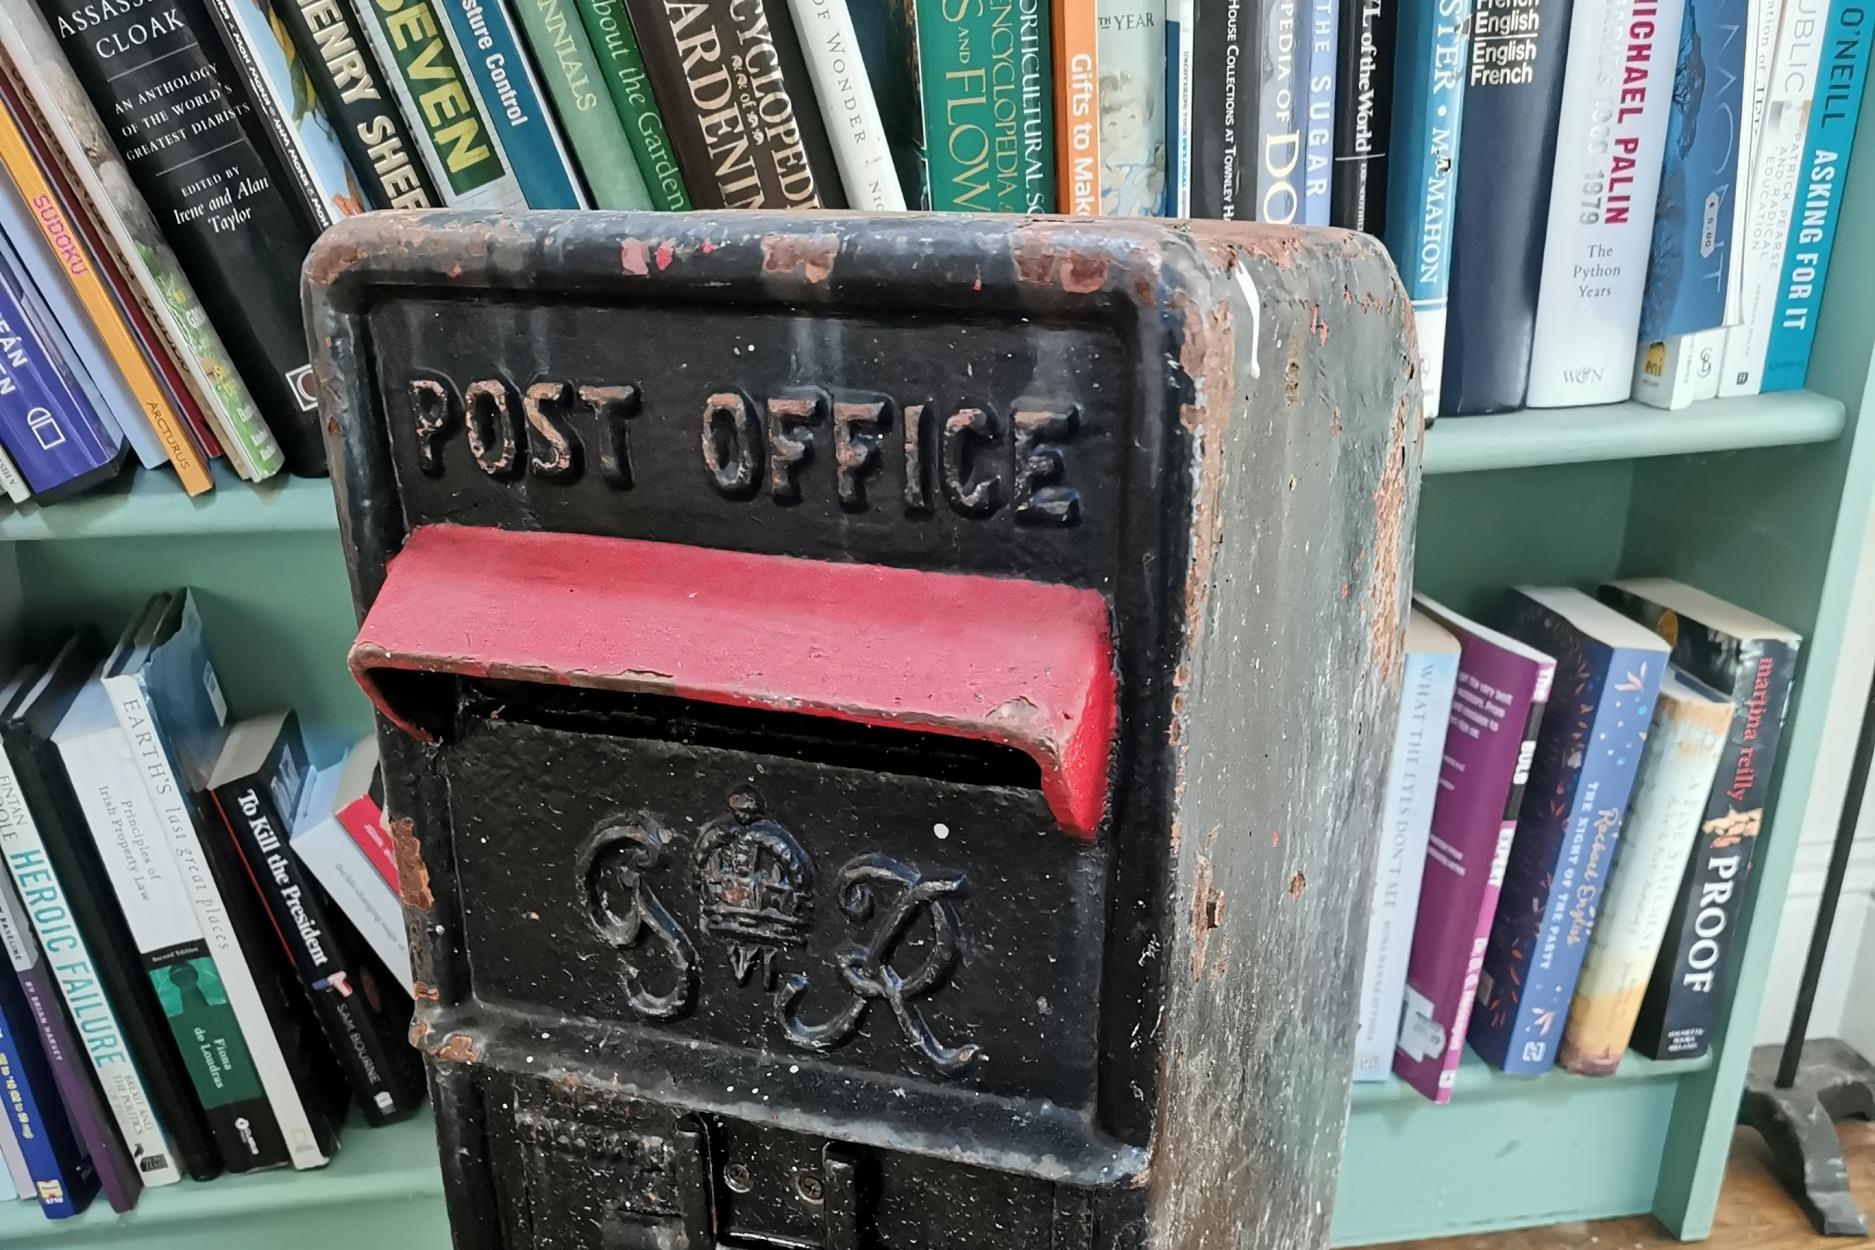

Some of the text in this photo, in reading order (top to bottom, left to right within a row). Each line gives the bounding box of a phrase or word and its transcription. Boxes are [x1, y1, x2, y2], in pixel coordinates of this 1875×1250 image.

[57, 0, 156, 39] ASSAS
[96, 8, 185, 59] CLOAK
[1113, 12, 1155, 31] YEAR
[1475, 11, 1540, 35] English
[300, 0, 381, 105] ENRY
[1276, 3, 1294, 122] PEDIA OF
[1359, 57, 1376, 90] the
[1470, 63, 1533, 86] French
[1472, 40, 1537, 65] English
[1758, 54, 1767, 72] of
[1821, 8, 1864, 129] O'NEILL
[114, 62, 219, 115] AN ANTHOLOGY
[121, 82, 233, 137] OF THE WORLD'S
[485, 53, 529, 127] Control
[740, 93, 757, 110] of
[826, 32, 867, 145] WONDER
[1071, 53, 1093, 117] Gifts
[1225, 44, 1240, 125] COLLECTIONS
[1306, 1, 1332, 197] THE SUGAR
[126, 102, 250, 161] GREATEST DIARISTS
[232, 33, 329, 228] HOW KNOW WHY KNOW HOW
[618, 67, 647, 105] the
[638, 111, 685, 211] Garden
[945, 26, 991, 212] AND FLOW
[1072, 121, 1093, 151] to
[1225, 128, 1235, 144] AT
[1355, 90, 1375, 152] World
[173, 176, 269, 225] Irene and Alan
[181, 165, 241, 198] EDITED BY
[1223, 145, 1237, 203] TOWNLEY
[1579, 170, 1605, 226] 1979
[1604, 138, 1639, 225] PALIN
[1752, 155, 1776, 251] EDUCATION
[1760, 146, 1787, 259] AND RADICAL
[1769, 133, 1802, 272] PATRICK PEARSE
[1799, 149, 1838, 244] ASKING
[33, 193, 88, 277] SUDOKU
[207, 206, 252, 234] Taylor
[1573, 264, 1621, 281] Python
[1588, 244, 1614, 258] The
[1787, 252, 1819, 300] FOR
[1578, 286, 1612, 298] Years
[1783, 308, 1809, 330] IT
[146, 401, 191, 471] ARCTURUS
[410, 378, 640, 488] POST
[703, 393, 1083, 525] OFFICE
[1411, 662, 1434, 723] WHAT
[1404, 727, 1423, 766] THE
[1727, 656, 1774, 801] martina reilly
[0, 775, 28, 826] FINTAN
[1396, 771, 1416, 815] EYES
[98, 786, 151, 902] Irish Property Law
[121, 800, 162, 880] Principles of
[123, 698, 229, 951] EARTH'S last great places
[237, 788, 329, 967] To Kill the President
[1539, 781, 1599, 970] THE NIGHT OF THE PARTY
[1683, 856, 1741, 994] PROOF
[10, 849, 127, 1069] HEROIC FAILURE
[31, 995, 48, 1024] BRIAN
[194, 1027, 225, 1090] de Londras
[213, 1037, 233, 1072] Fiona
[336, 1003, 381, 1085] SAM BOURNE
